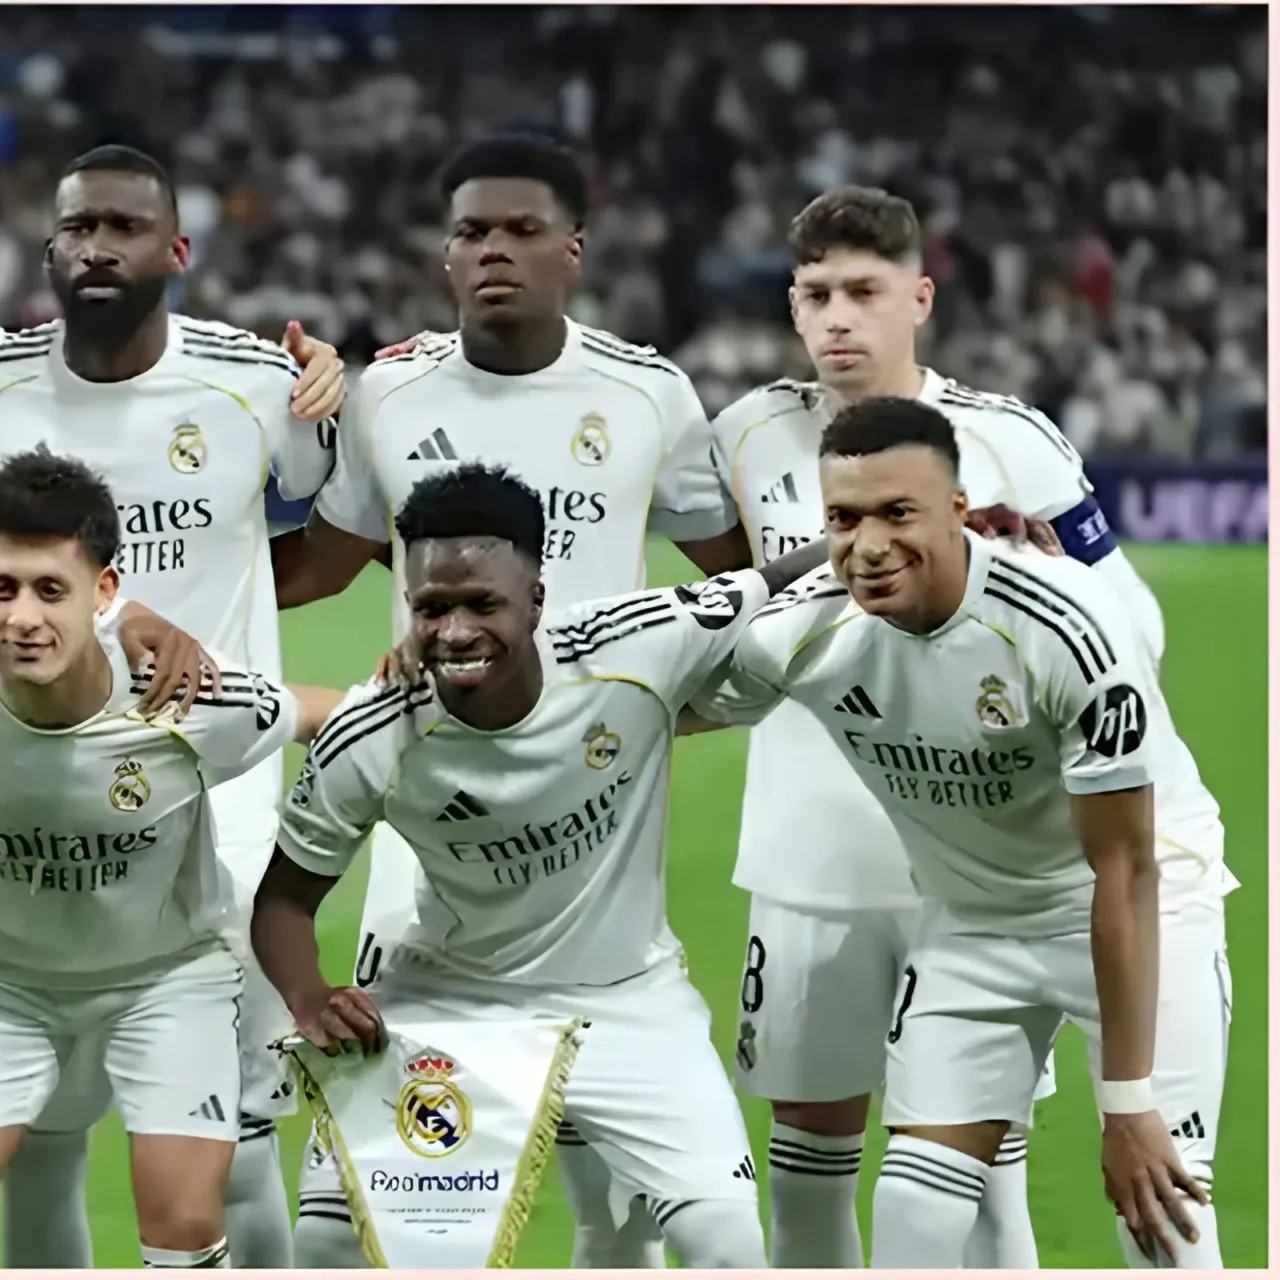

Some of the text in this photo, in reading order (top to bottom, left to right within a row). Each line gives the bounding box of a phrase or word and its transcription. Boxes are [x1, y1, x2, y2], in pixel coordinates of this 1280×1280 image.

[844, 729, 1035, 777] Emirates
[927, 779, 1014, 808] BETTER
[741, 936, 767, 1013] 8
